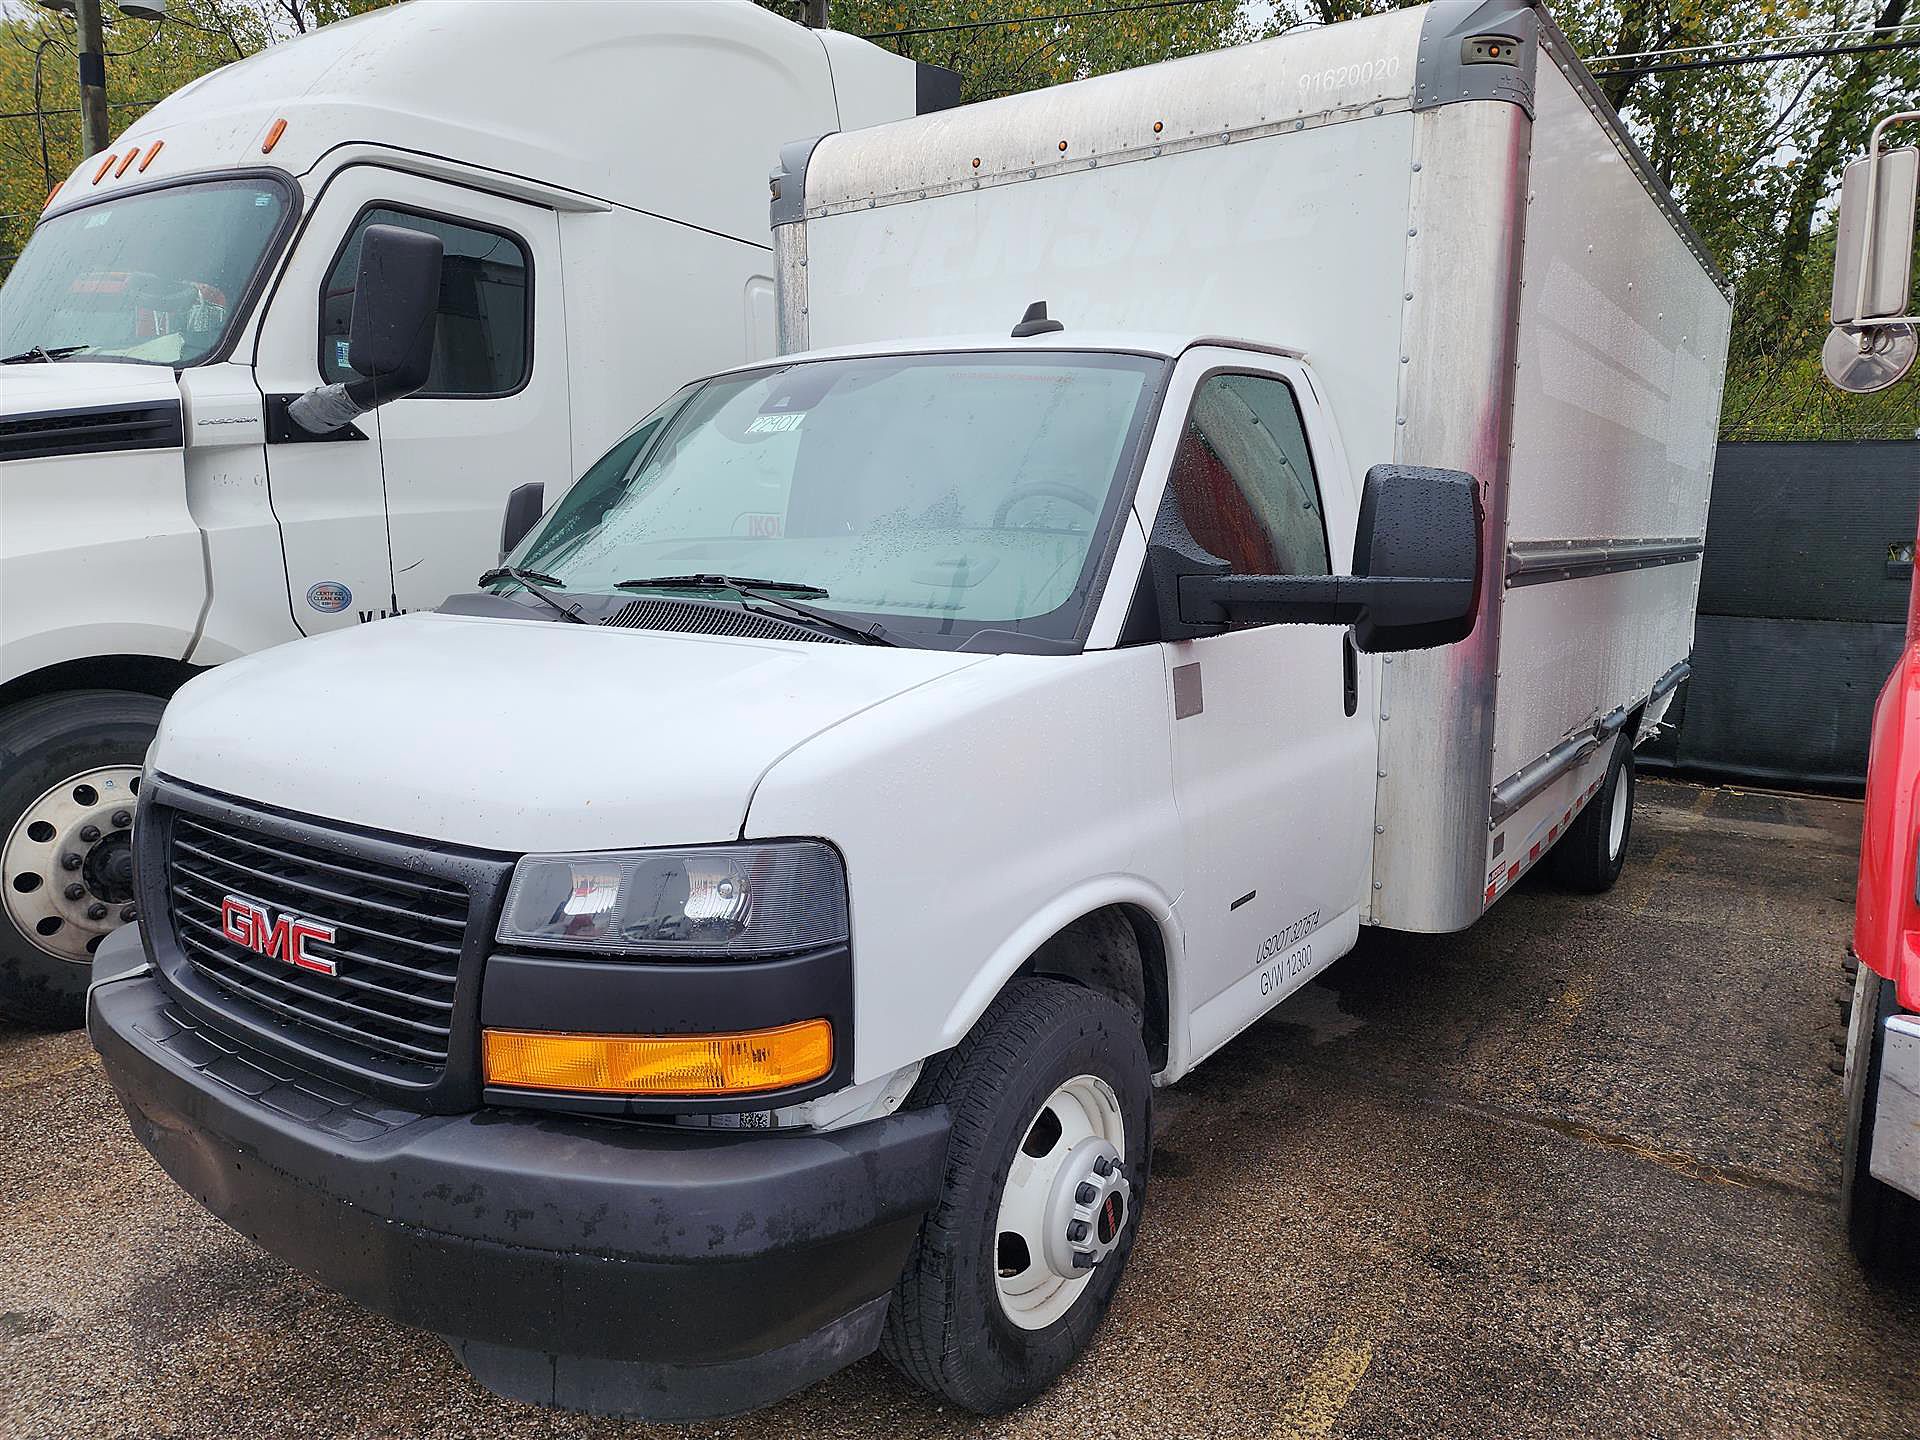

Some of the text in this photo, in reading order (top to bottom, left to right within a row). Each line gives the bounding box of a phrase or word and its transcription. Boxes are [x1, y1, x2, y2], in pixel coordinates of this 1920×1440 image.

[1299, 56, 1400, 95] 91620020
[842, 134, 1353, 296] PENSKE
[222, 894, 338, 977] GMC
[1256, 926, 1291, 964] USDOT
[1260, 945, 1312, 996] GVW 12300
[1106, 1197, 1116, 1238] GMC
